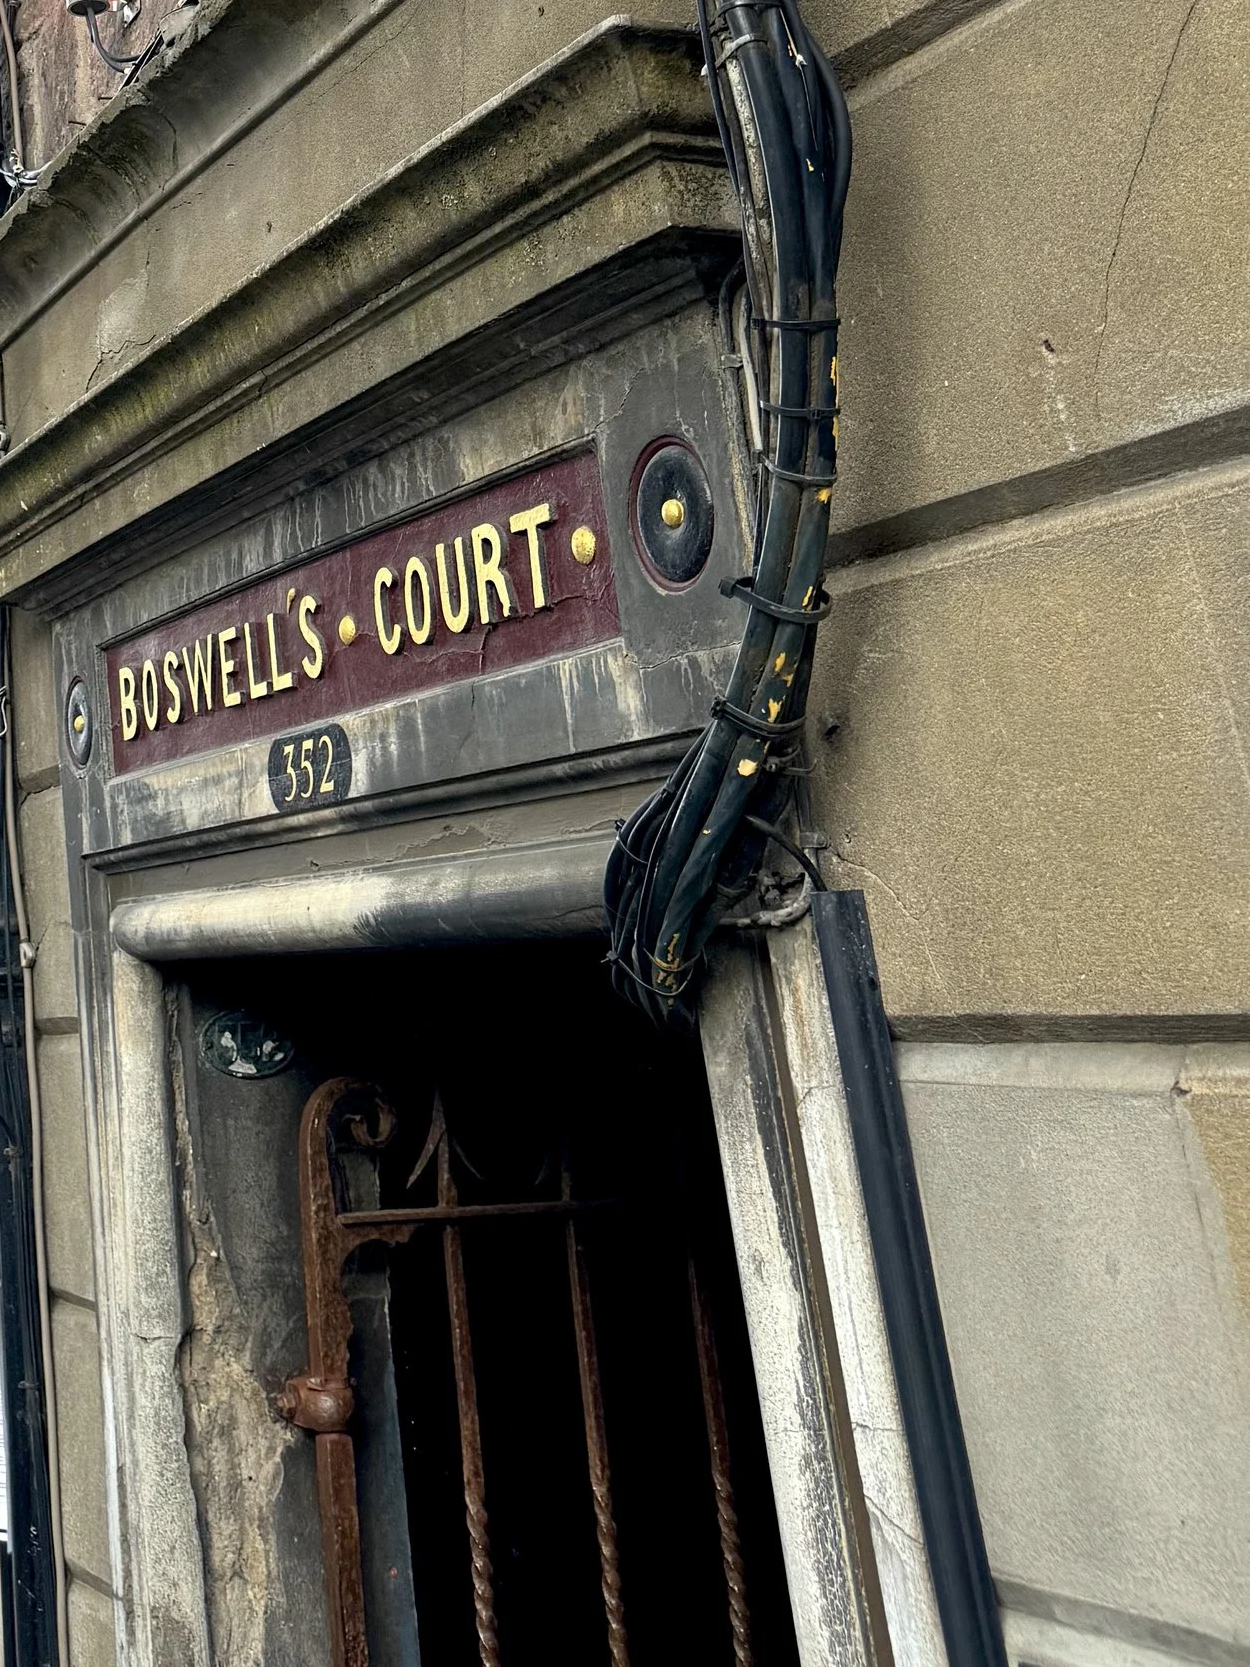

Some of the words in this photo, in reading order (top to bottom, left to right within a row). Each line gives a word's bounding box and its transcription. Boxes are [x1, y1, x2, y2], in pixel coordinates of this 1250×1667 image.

[119, 587, 324, 741] BOSWELL'S
[374, 502, 551, 655] COURT
[282, 735, 335, 802] 352
